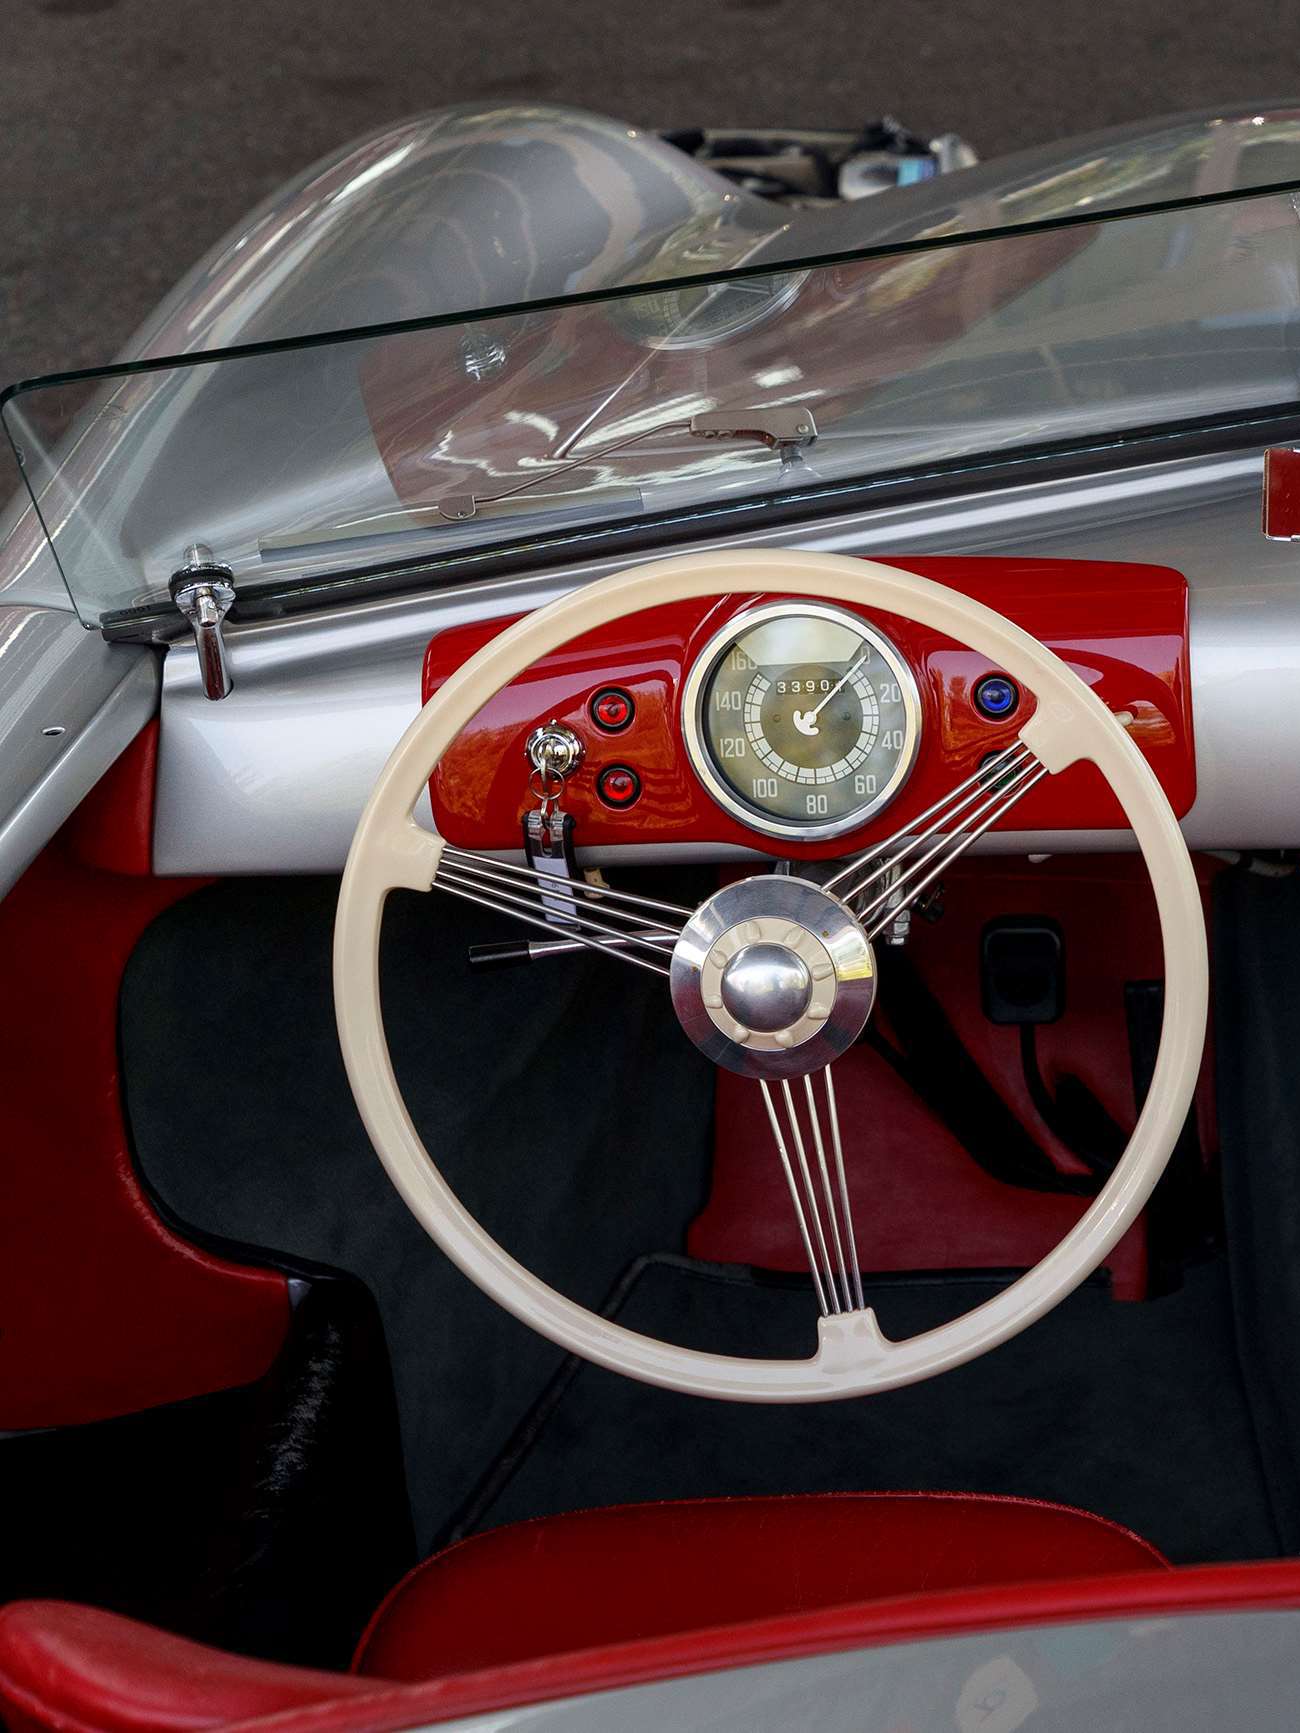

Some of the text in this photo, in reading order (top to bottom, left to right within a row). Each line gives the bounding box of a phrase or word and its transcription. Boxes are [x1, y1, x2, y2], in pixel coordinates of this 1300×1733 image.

[715, 692, 742, 711] 140
[880, 684, 901, 703] 20
[719, 738, 746, 758] 120
[881, 731, 903, 750] 40
[753, 778, 778, 798] 100
[854, 775, 876, 794] 60
[806, 795, 828, 814] 80
